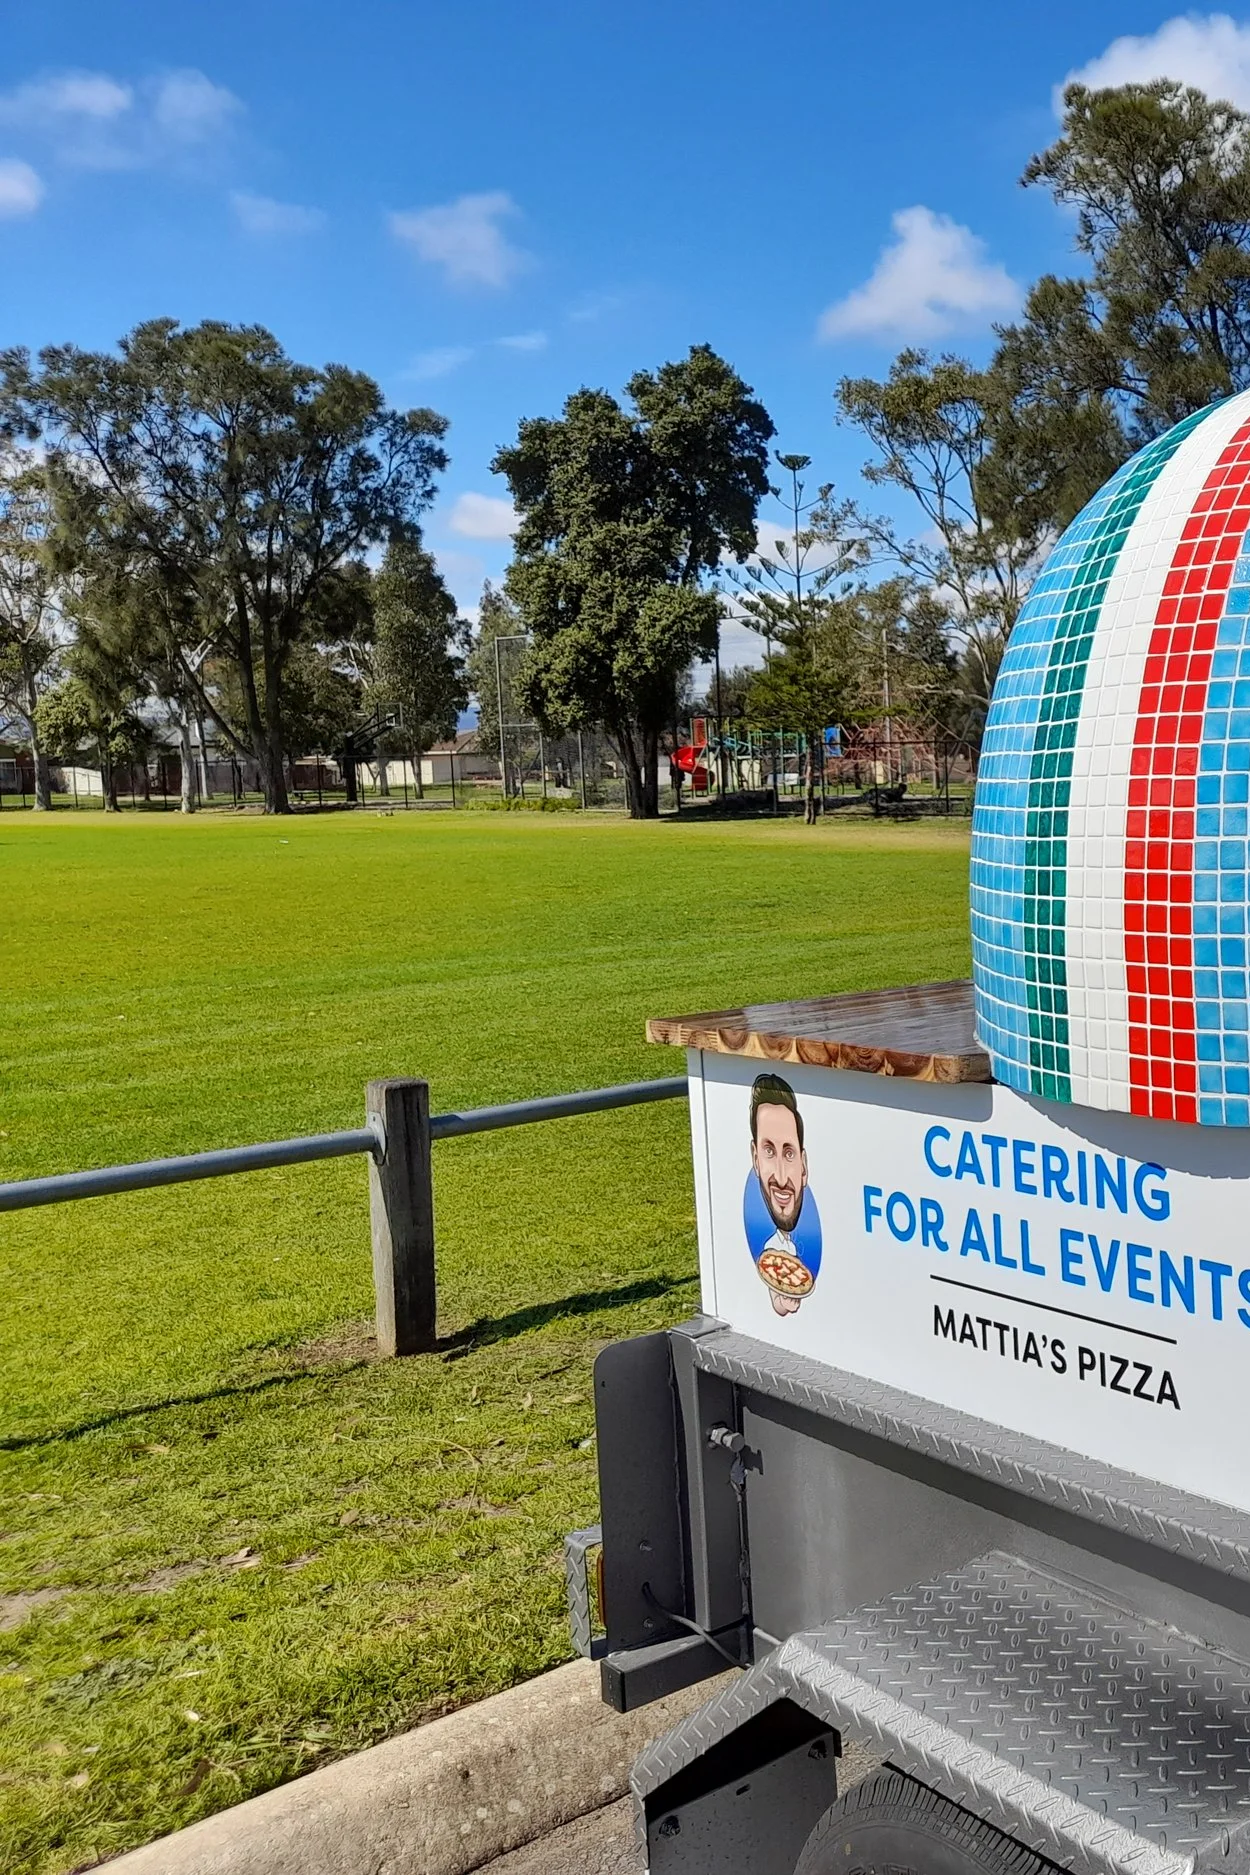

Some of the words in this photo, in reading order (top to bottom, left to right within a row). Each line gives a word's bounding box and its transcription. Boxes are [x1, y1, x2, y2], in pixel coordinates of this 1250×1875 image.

[924, 1125, 1172, 1222] CATERING
[863, 1185, 950, 1253] FOR
[959, 1208, 1046, 1276] ALL
[933, 1304, 1068, 1375] MATTIA'S
[1078, 1345, 1181, 1411] PIZZA
